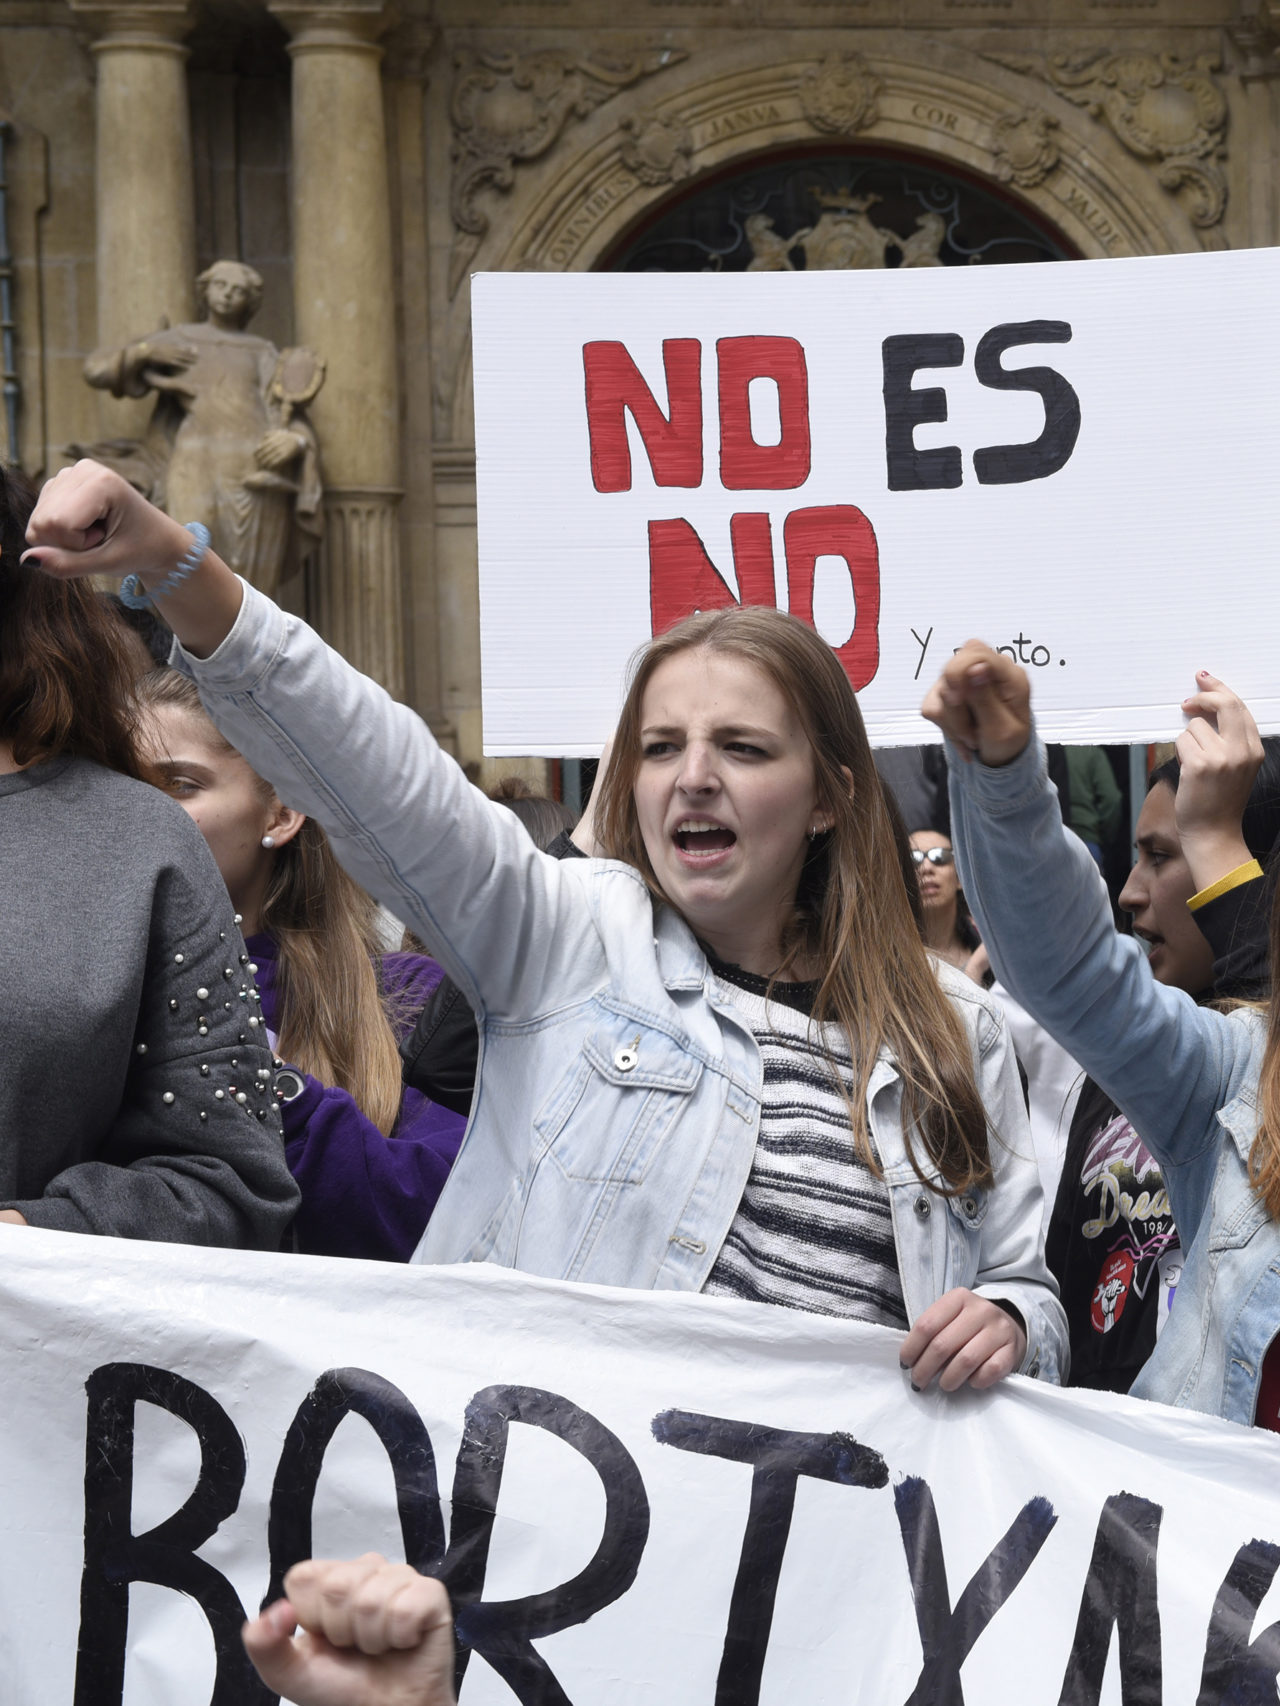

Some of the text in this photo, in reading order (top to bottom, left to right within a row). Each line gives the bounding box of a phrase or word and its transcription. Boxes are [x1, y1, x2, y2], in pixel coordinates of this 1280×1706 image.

[911, 103, 960, 131] COR
[581, 318, 1081, 493] NO ES
[648, 504, 880, 693] NO
[953, 631, 1067, 667] nto.
[1082, 1171, 1172, 1240] Drea
